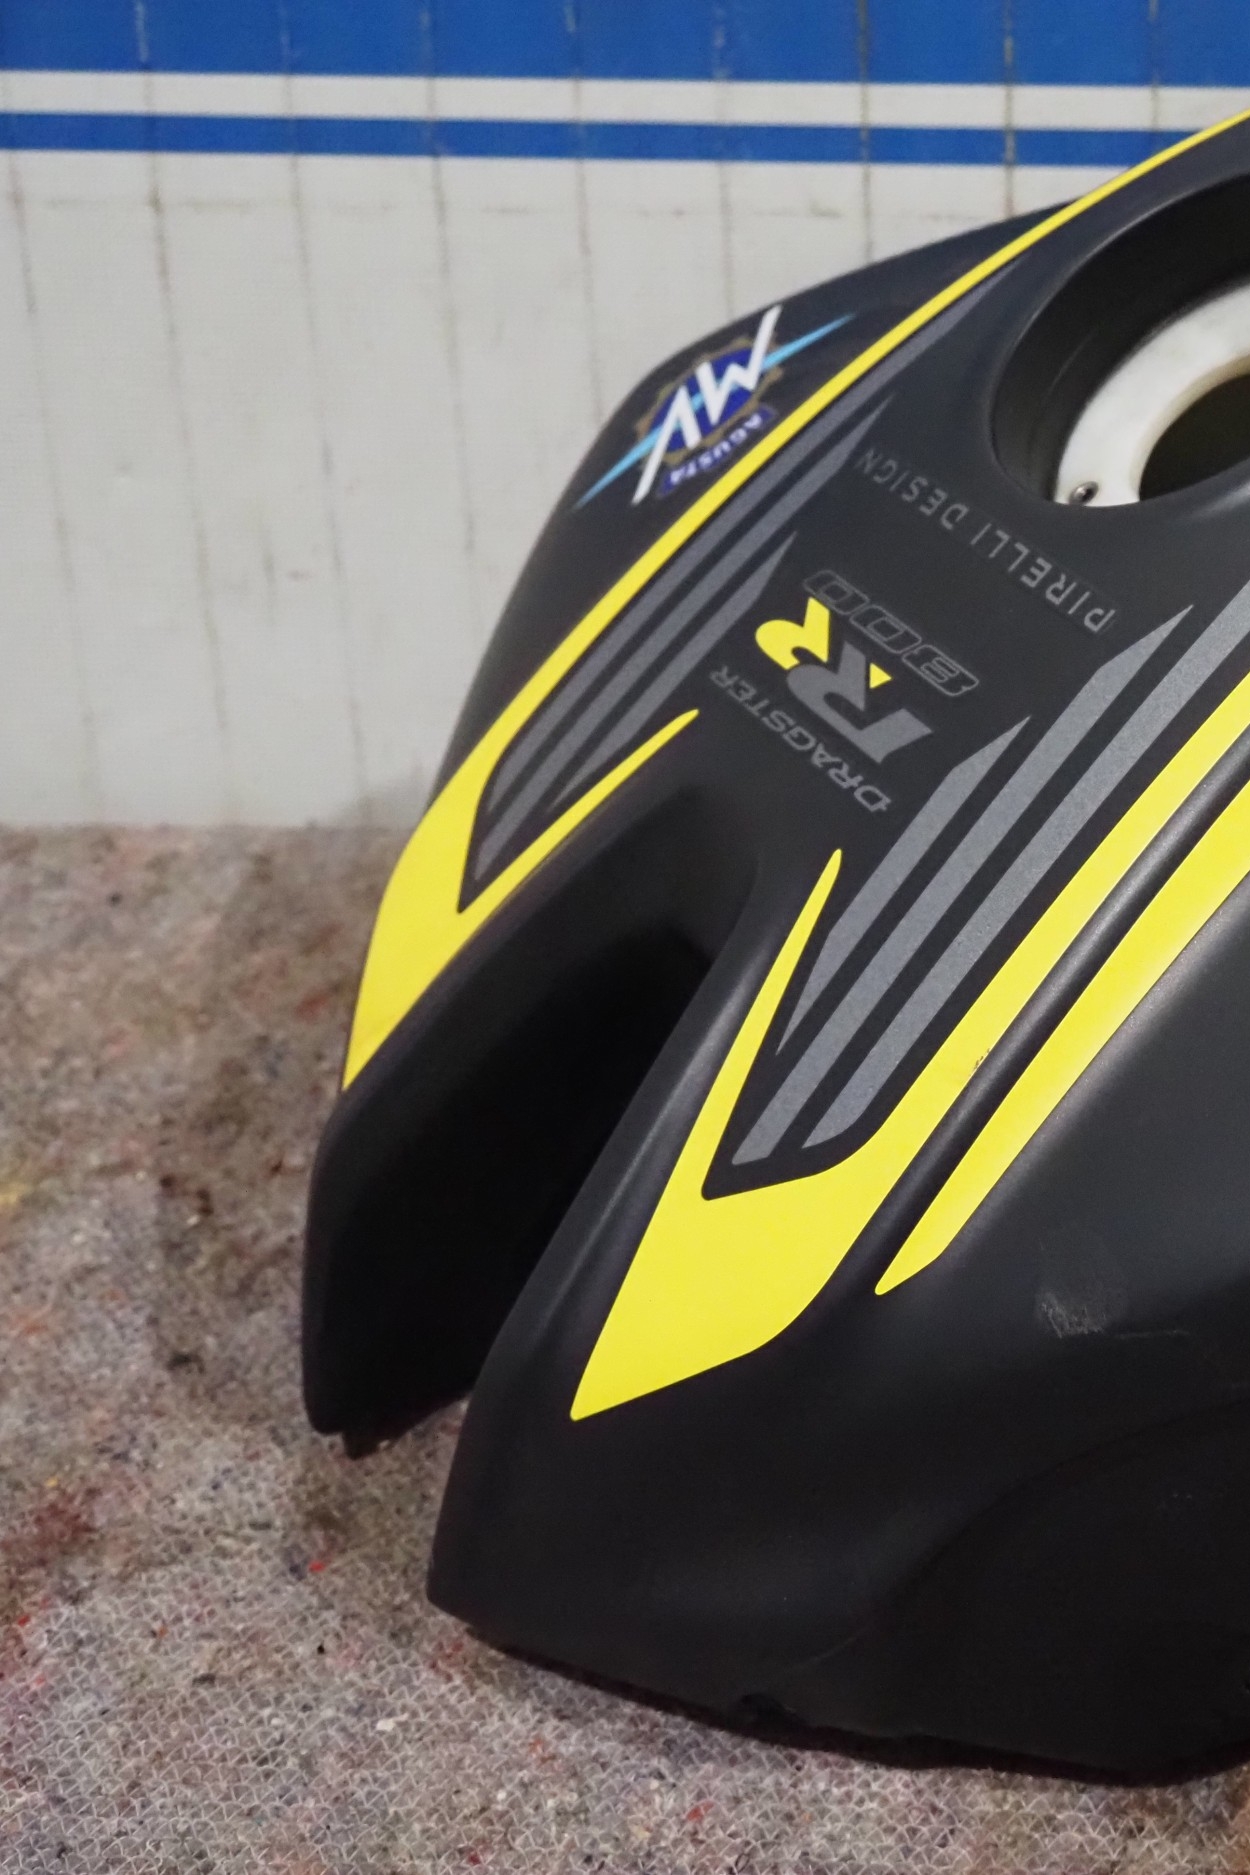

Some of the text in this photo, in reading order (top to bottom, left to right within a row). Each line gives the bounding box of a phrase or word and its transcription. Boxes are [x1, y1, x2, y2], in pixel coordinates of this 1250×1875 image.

[858, 449, 1116, 633] PIRELLI DESIGN
[755, 597, 934, 764] RR
[804, 569, 979, 697] 800
[710, 665, 893, 813] DRAGSTER
